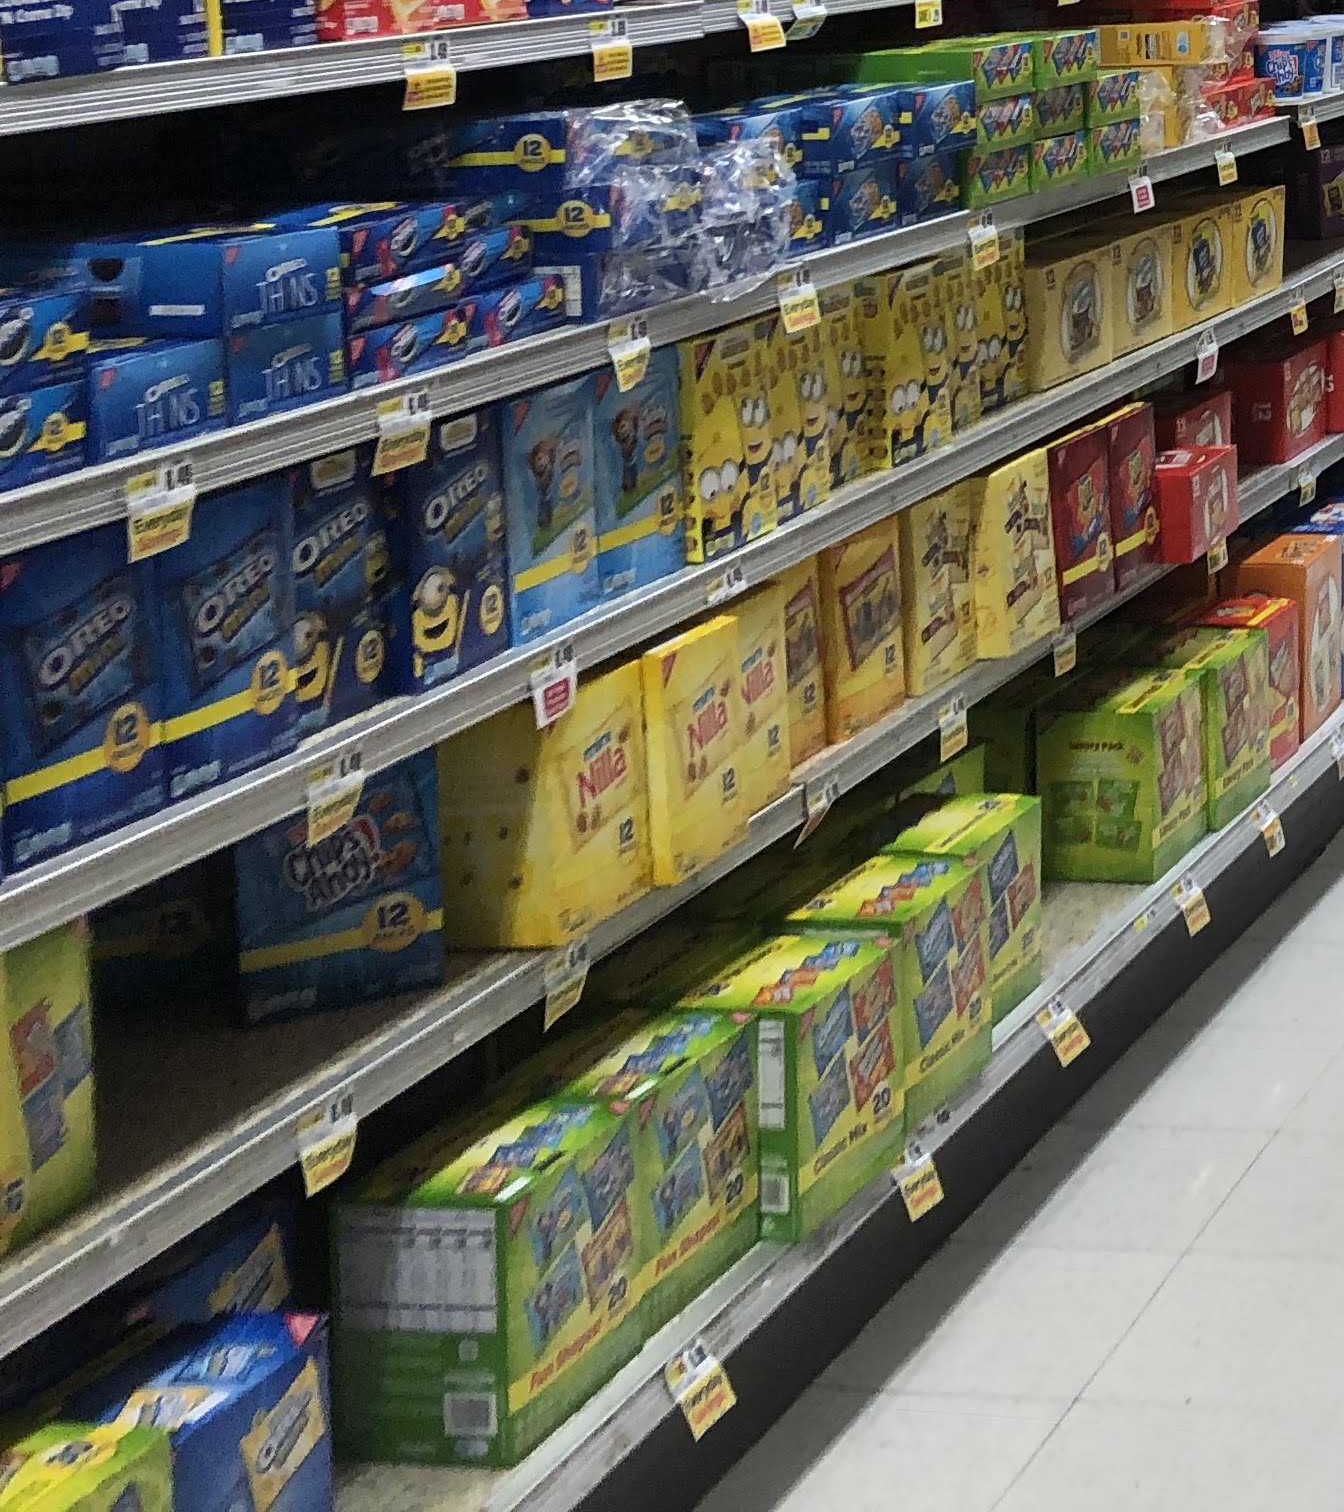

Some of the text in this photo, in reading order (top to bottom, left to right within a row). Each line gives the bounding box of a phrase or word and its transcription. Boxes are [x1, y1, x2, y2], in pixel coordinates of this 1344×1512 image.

[523, 139, 543, 158] 12
[565, 205, 584, 224] 12
[424, 461, 490, 530] OREO
[660, 493, 677, 521] 12
[293, 500, 370, 573] OREO
[573, 528, 590, 555] 12
[199, 550, 277, 634] OREO
[39, 596, 132, 687] OREO
[260, 657, 280, 688] 12
[741, 657, 776, 707] Nilla
[116, 715, 140, 747] 12
[687, 698, 729, 759] Nilla
[576, 743, 628, 810] Nilla
[722, 767, 737, 792] 12
[619, 817, 635, 845] 12
[377, 901, 409, 929] 12
[872, 1087, 892, 1115] 20
